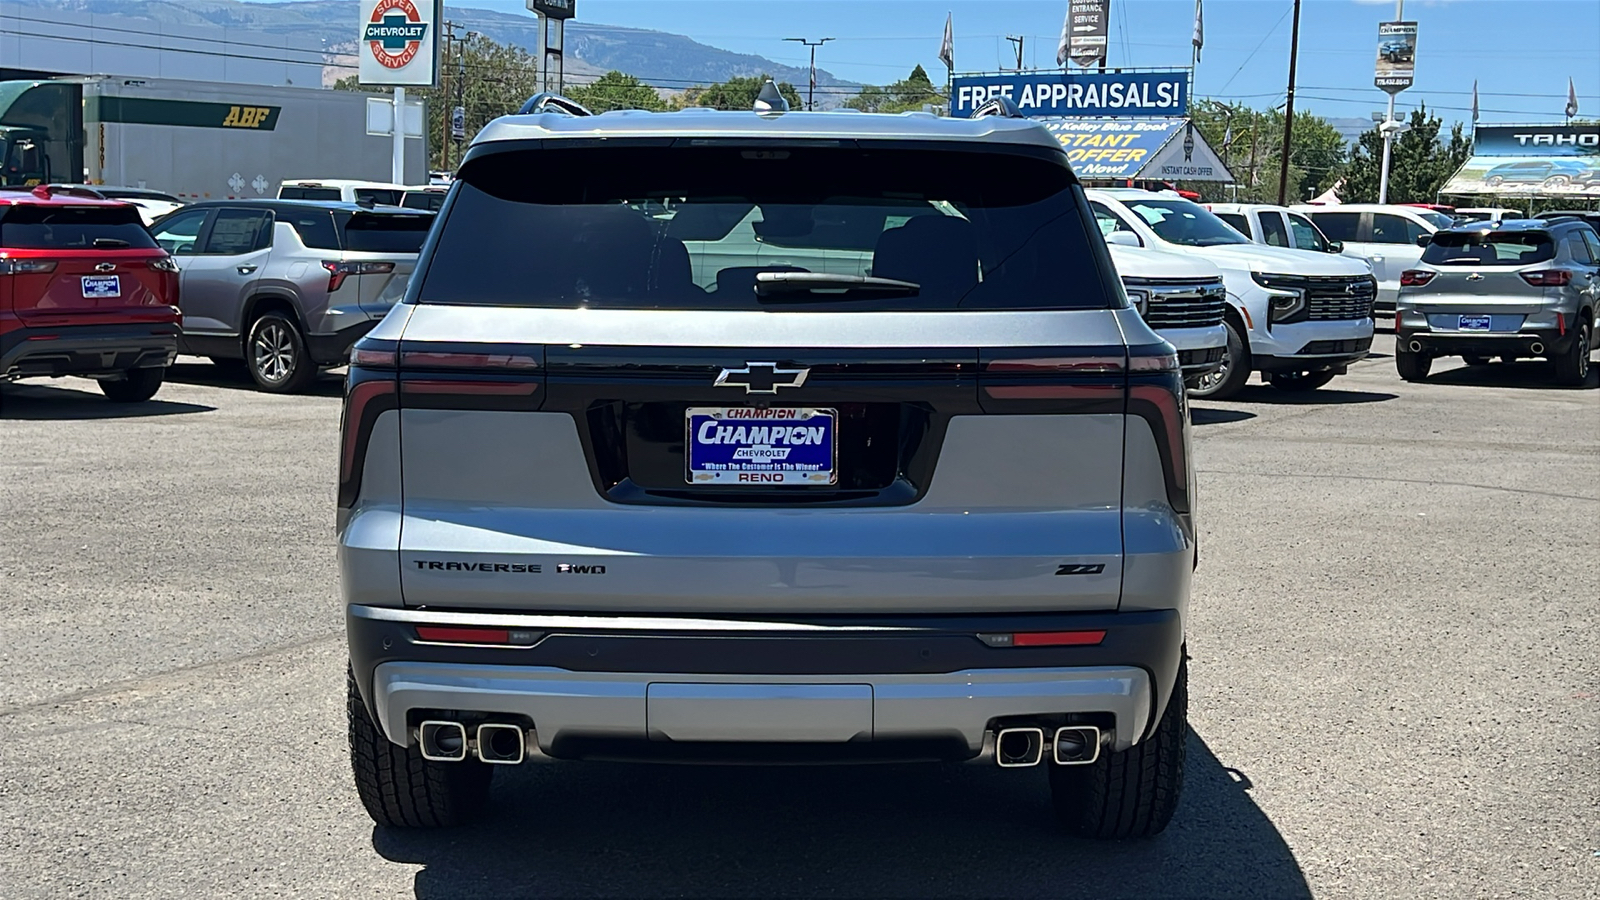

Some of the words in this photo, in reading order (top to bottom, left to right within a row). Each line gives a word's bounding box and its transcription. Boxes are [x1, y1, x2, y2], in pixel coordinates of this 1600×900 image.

[377, 0, 414, 15] SUPER
[1072, 5, 1103, 13] ENTRANCE
[1074, 15, 1099, 23] SERVICE
[367, 27, 423, 36] CHEVROLET
[373, 44, 416, 67] SERVICE
[1018, 82, 1180, 109] APPRAISALS!
[222, 106, 270, 128] ABF
[1060, 122, 1102, 133] Kelley
[1101, 122, 1132, 131] Blue
[1054, 133, 1142, 147] STANT
[1067, 149, 1148, 162] OFFER
[1082, 163, 1129, 174] Now!
[1161, 165, 1183, 175] INSTANT
[1183, 166, 1197, 176] CASH
[1198, 167, 1213, 176] OFFER
[727, 409, 796, 419] CHAMPION
[697, 420, 826, 446] CHAMPION
[736, 449, 787, 457] CHEVROLET
[738, 473, 784, 482] RENO
[413, 560, 542, 574] TRAVERSE
[556, 563, 606, 575] AWD
[1055, 563, 1106, 576] Z71
